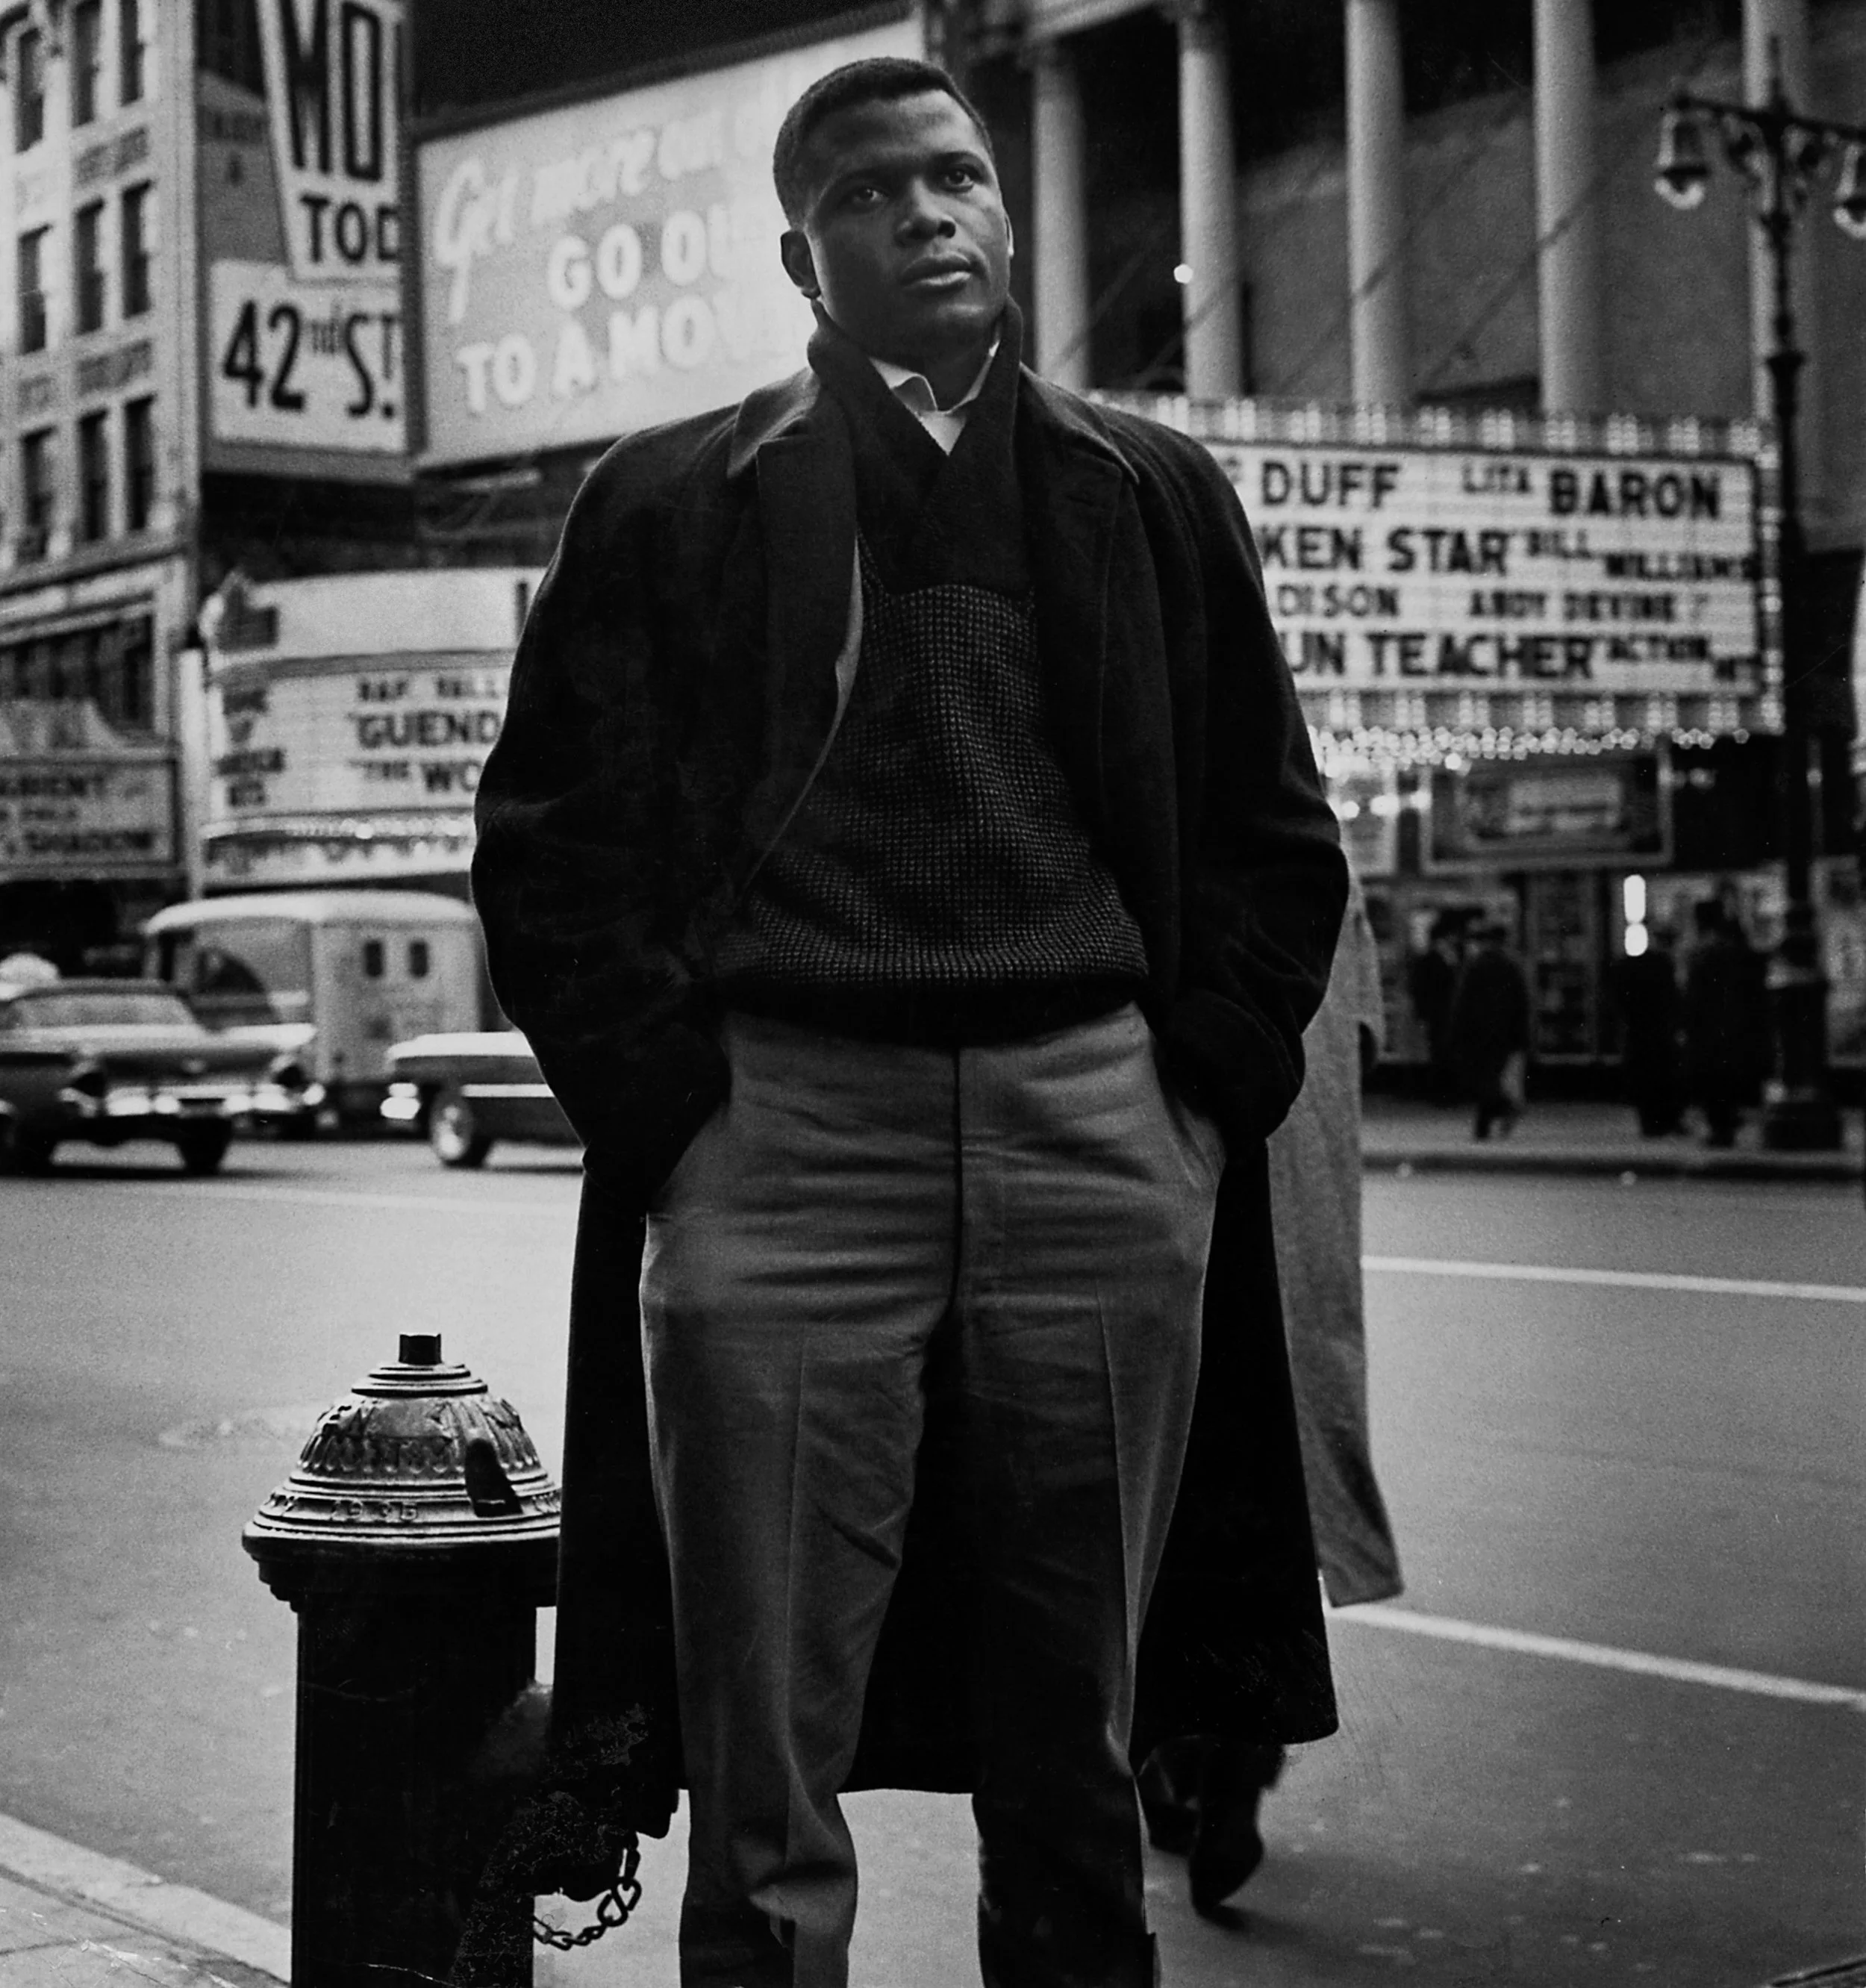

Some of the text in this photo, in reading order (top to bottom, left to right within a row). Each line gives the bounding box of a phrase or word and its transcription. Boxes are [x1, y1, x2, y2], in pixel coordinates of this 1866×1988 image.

[547, 221, 643, 310] GO
[455, 334, 537, 416] TO
[553, 320, 596, 398] A
[1261, 459, 1401, 509] DUFF
[1548, 467, 1720, 520] BARON
[1385, 526, 1511, 576] STAR
[1276, 582, 1400, 619] DISON
[1364, 632, 1594, 681] TEACHER
